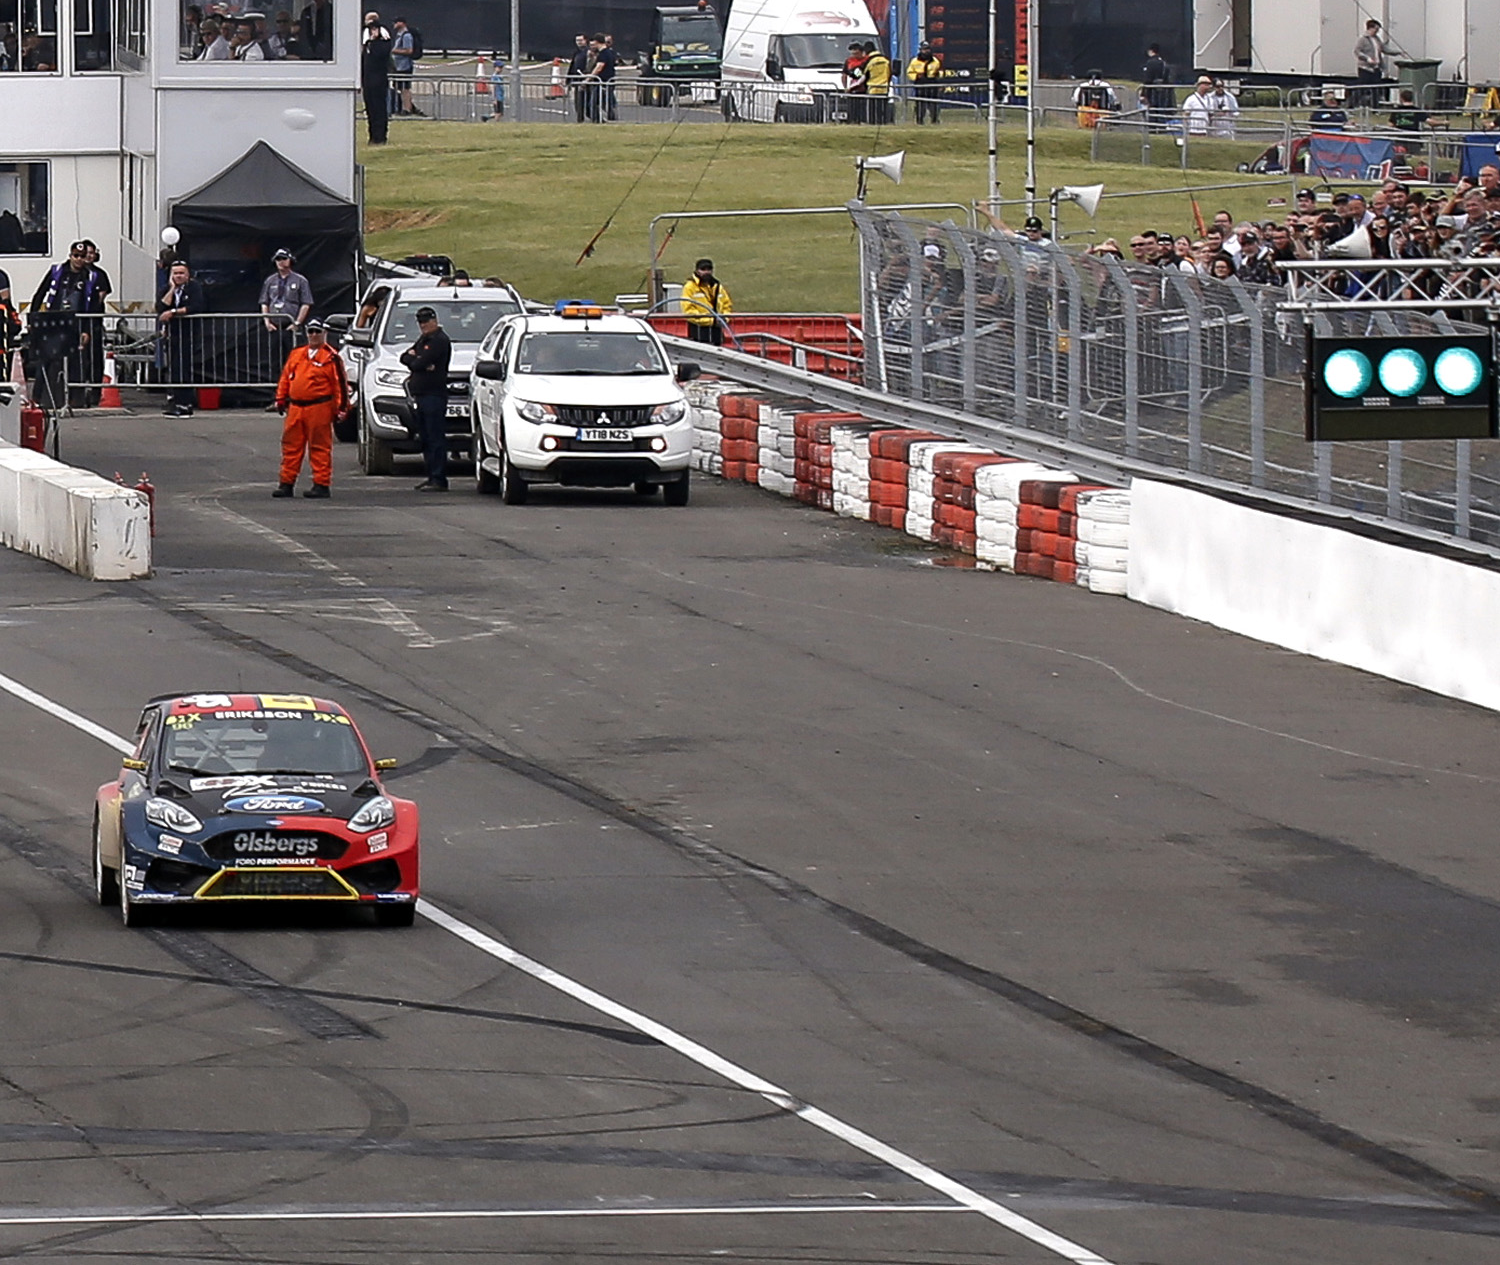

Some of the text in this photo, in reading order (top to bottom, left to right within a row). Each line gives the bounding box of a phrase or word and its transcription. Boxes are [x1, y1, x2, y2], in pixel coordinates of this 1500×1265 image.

[609, 428, 629, 440] NZS
[214, 710, 304, 720] ERIKSSON
[242, 796, 307, 812] Ford
[234, 832, 319, 856] Olsbergs
